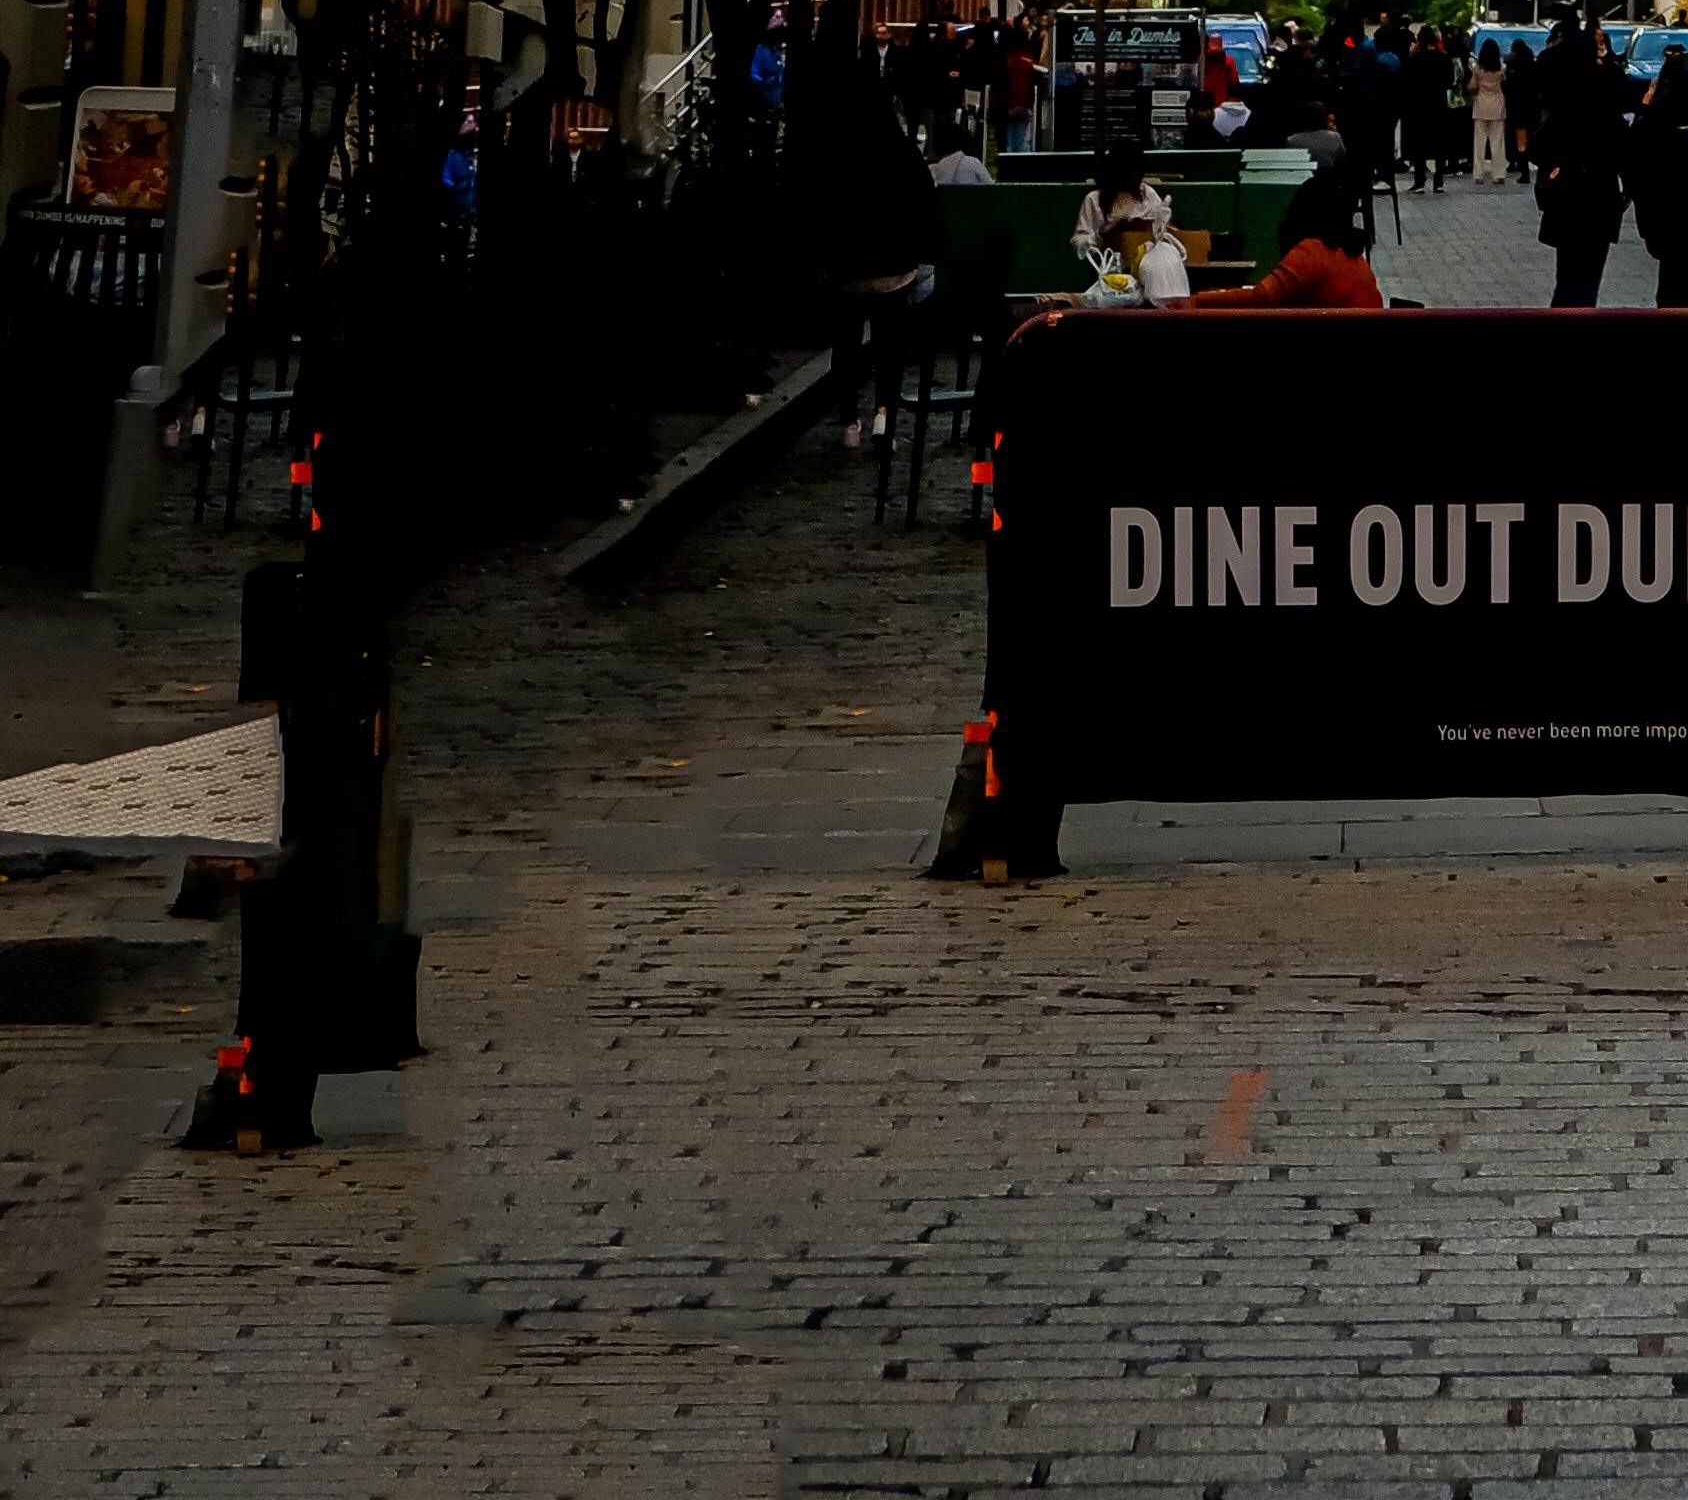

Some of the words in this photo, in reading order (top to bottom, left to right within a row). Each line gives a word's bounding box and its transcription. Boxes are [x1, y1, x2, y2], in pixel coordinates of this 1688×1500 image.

[1109, 505, 1319, 608] DINE
[1349, 503, 1526, 606] OUT
[1437, 724, 1492, 741] You've
[1496, 726, 1545, 740] never
[1550, 721, 1591, 739] been
[1596, 725, 1640, 739] more
